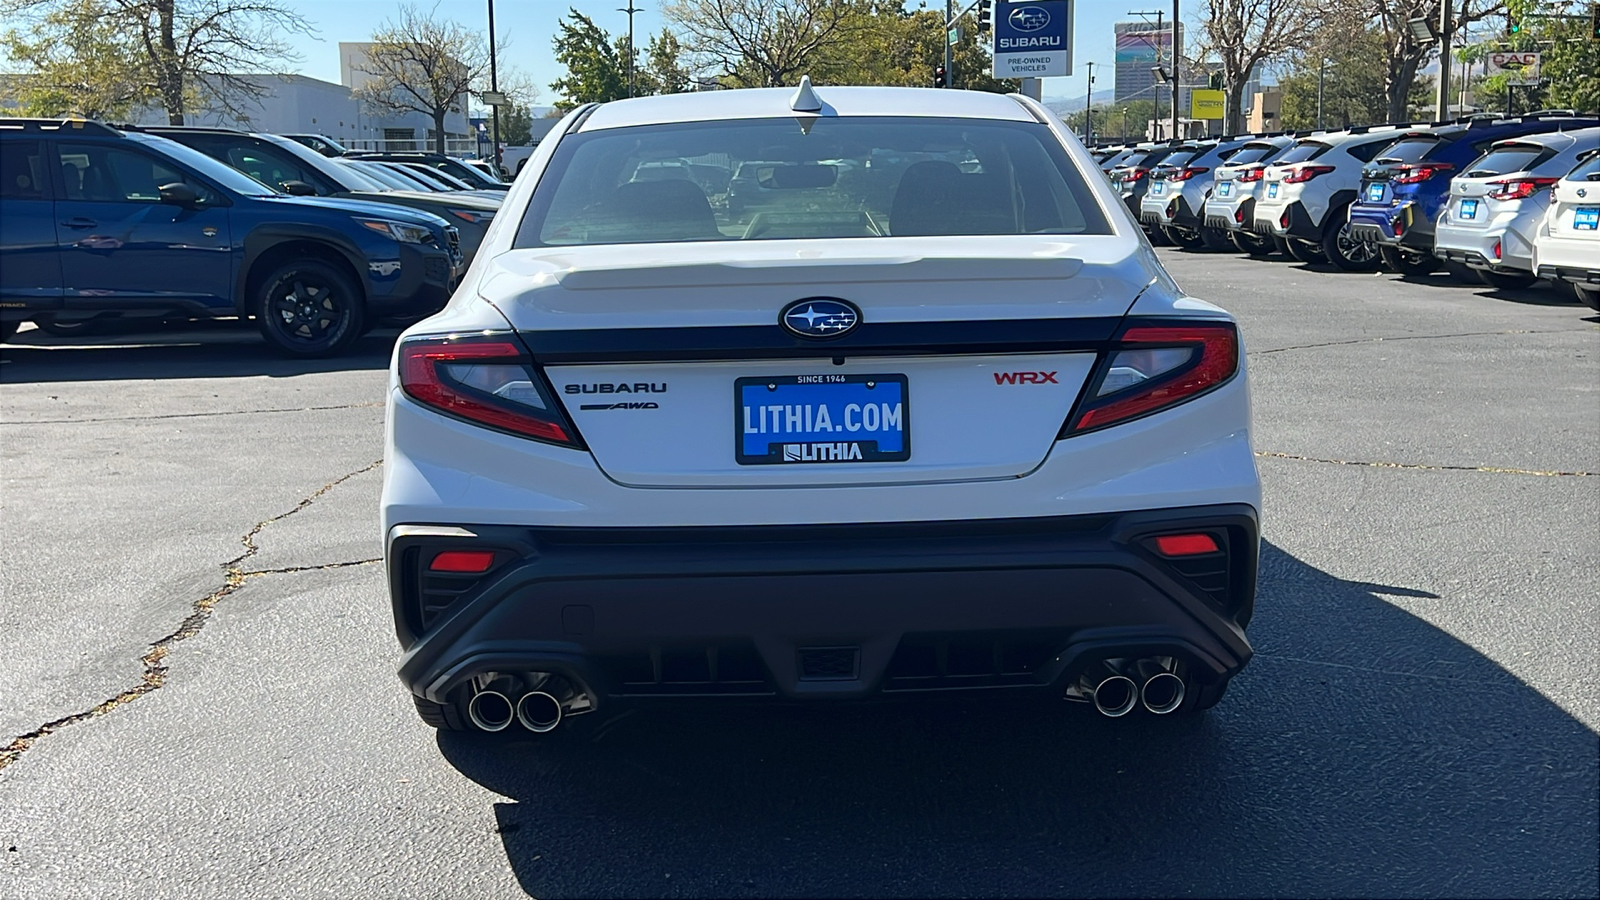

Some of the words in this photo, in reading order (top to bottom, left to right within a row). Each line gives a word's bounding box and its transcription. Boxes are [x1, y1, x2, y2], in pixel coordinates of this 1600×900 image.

[1000, 36, 1060, 48] SUBARU
[1008, 57, 1051, 65] PRE-OWNED
[1011, 64, 1047, 72] VEHICLES
[797, 376, 823, 384] SINCE
[826, 375, 846, 383] 1946
[993, 371, 1059, 385] WRX
[564, 382, 667, 395] SUBARU
[609, 401, 659, 410] AWD
[743, 402, 903, 434] LITHIA.COM
[801, 442, 863, 461] LITHIA
